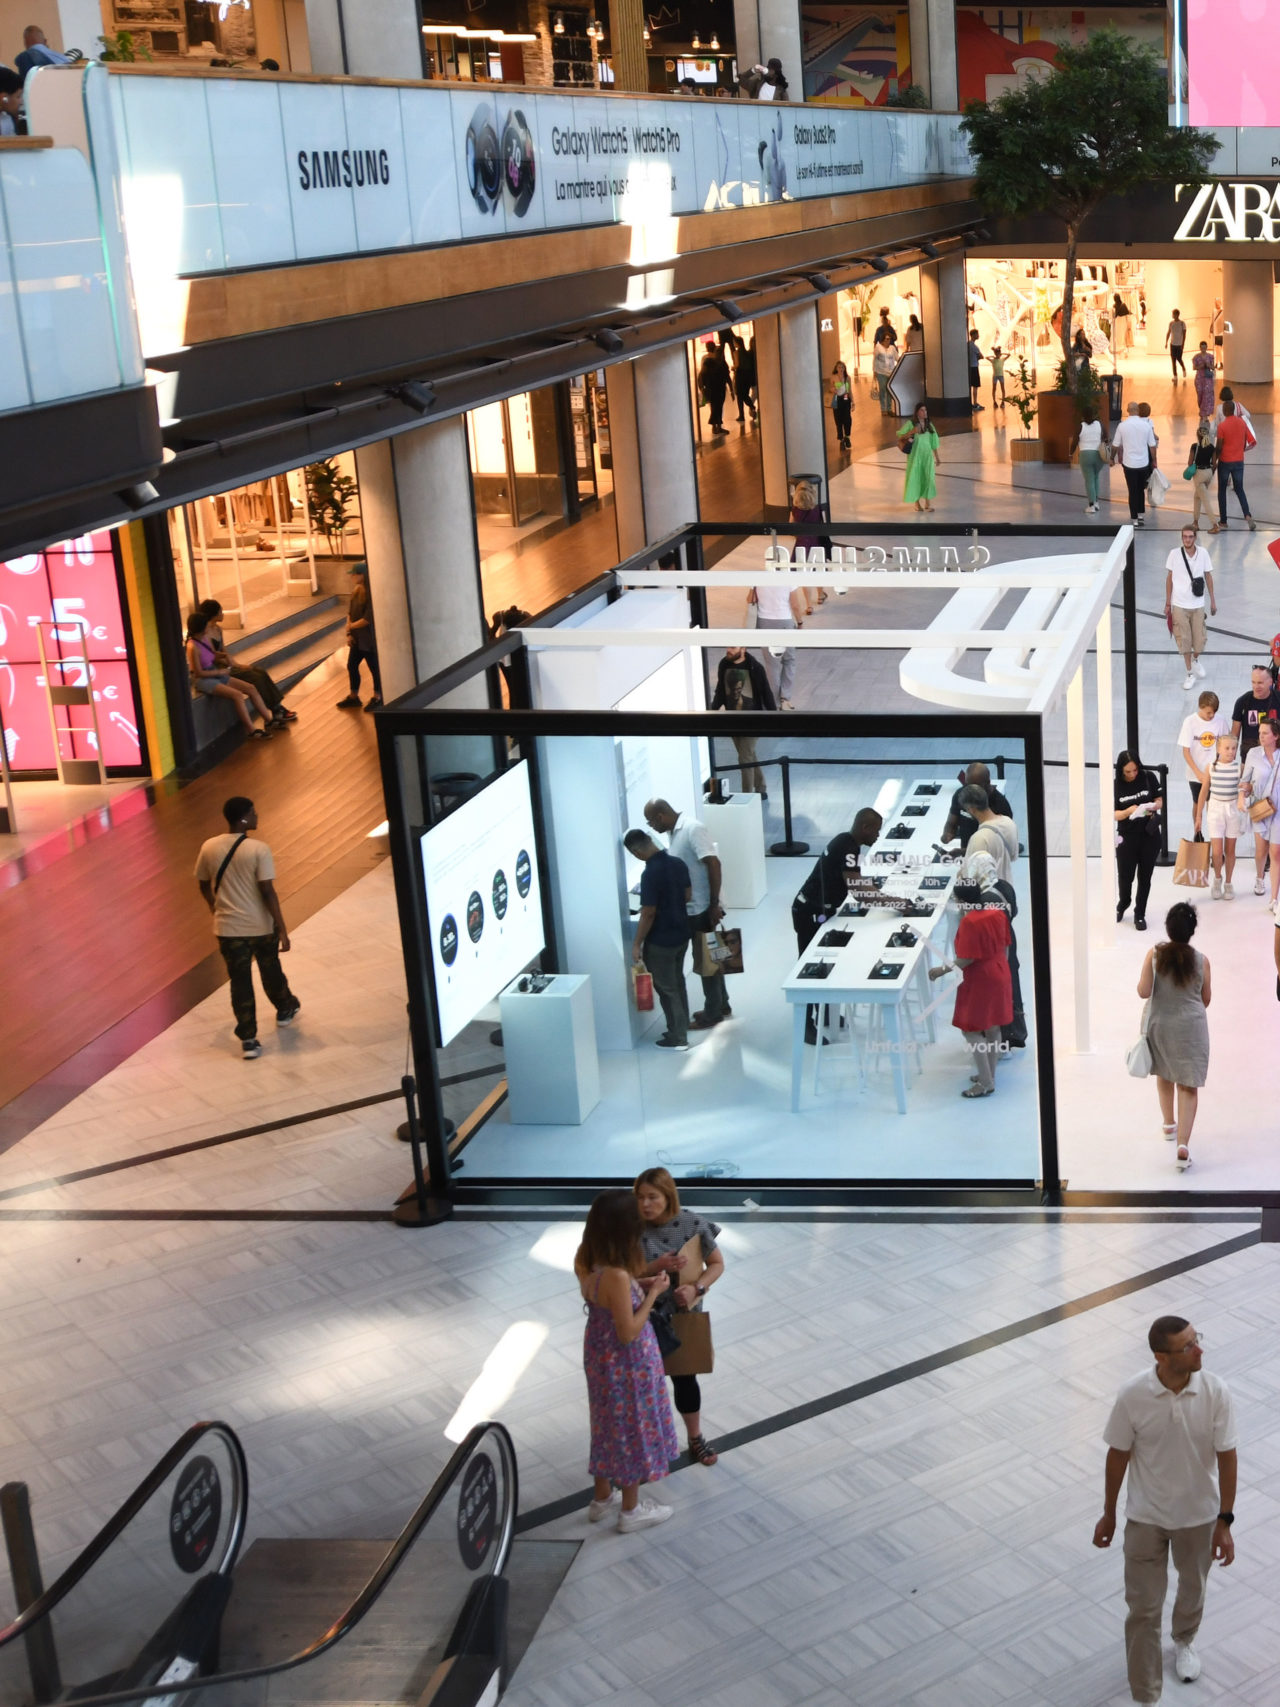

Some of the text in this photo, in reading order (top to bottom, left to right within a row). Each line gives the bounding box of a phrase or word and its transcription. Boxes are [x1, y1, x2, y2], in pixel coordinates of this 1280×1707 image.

[552, 126, 680, 162] Galaxy Watch5 Watch5 Pro
[794, 125, 812, 150] Galaxy
[828, 125, 836, 144] Pro
[298, 148, 390, 191] SAMSUNG
[555, 180, 565, 200] La
[597, 175, 607, 203] qui
[609, 179, 624, 196] vous
[845, 853, 932, 868] SAMSUNG
[847, 878, 873, 886] Lundi
[925, 878, 940, 886] 10h
[950, 878, 976, 886] 0h30
[860, 901, 882, 909] Août
[984, 902, 1005, 910] 2022
[963, 1040, 1009, 1053] world
